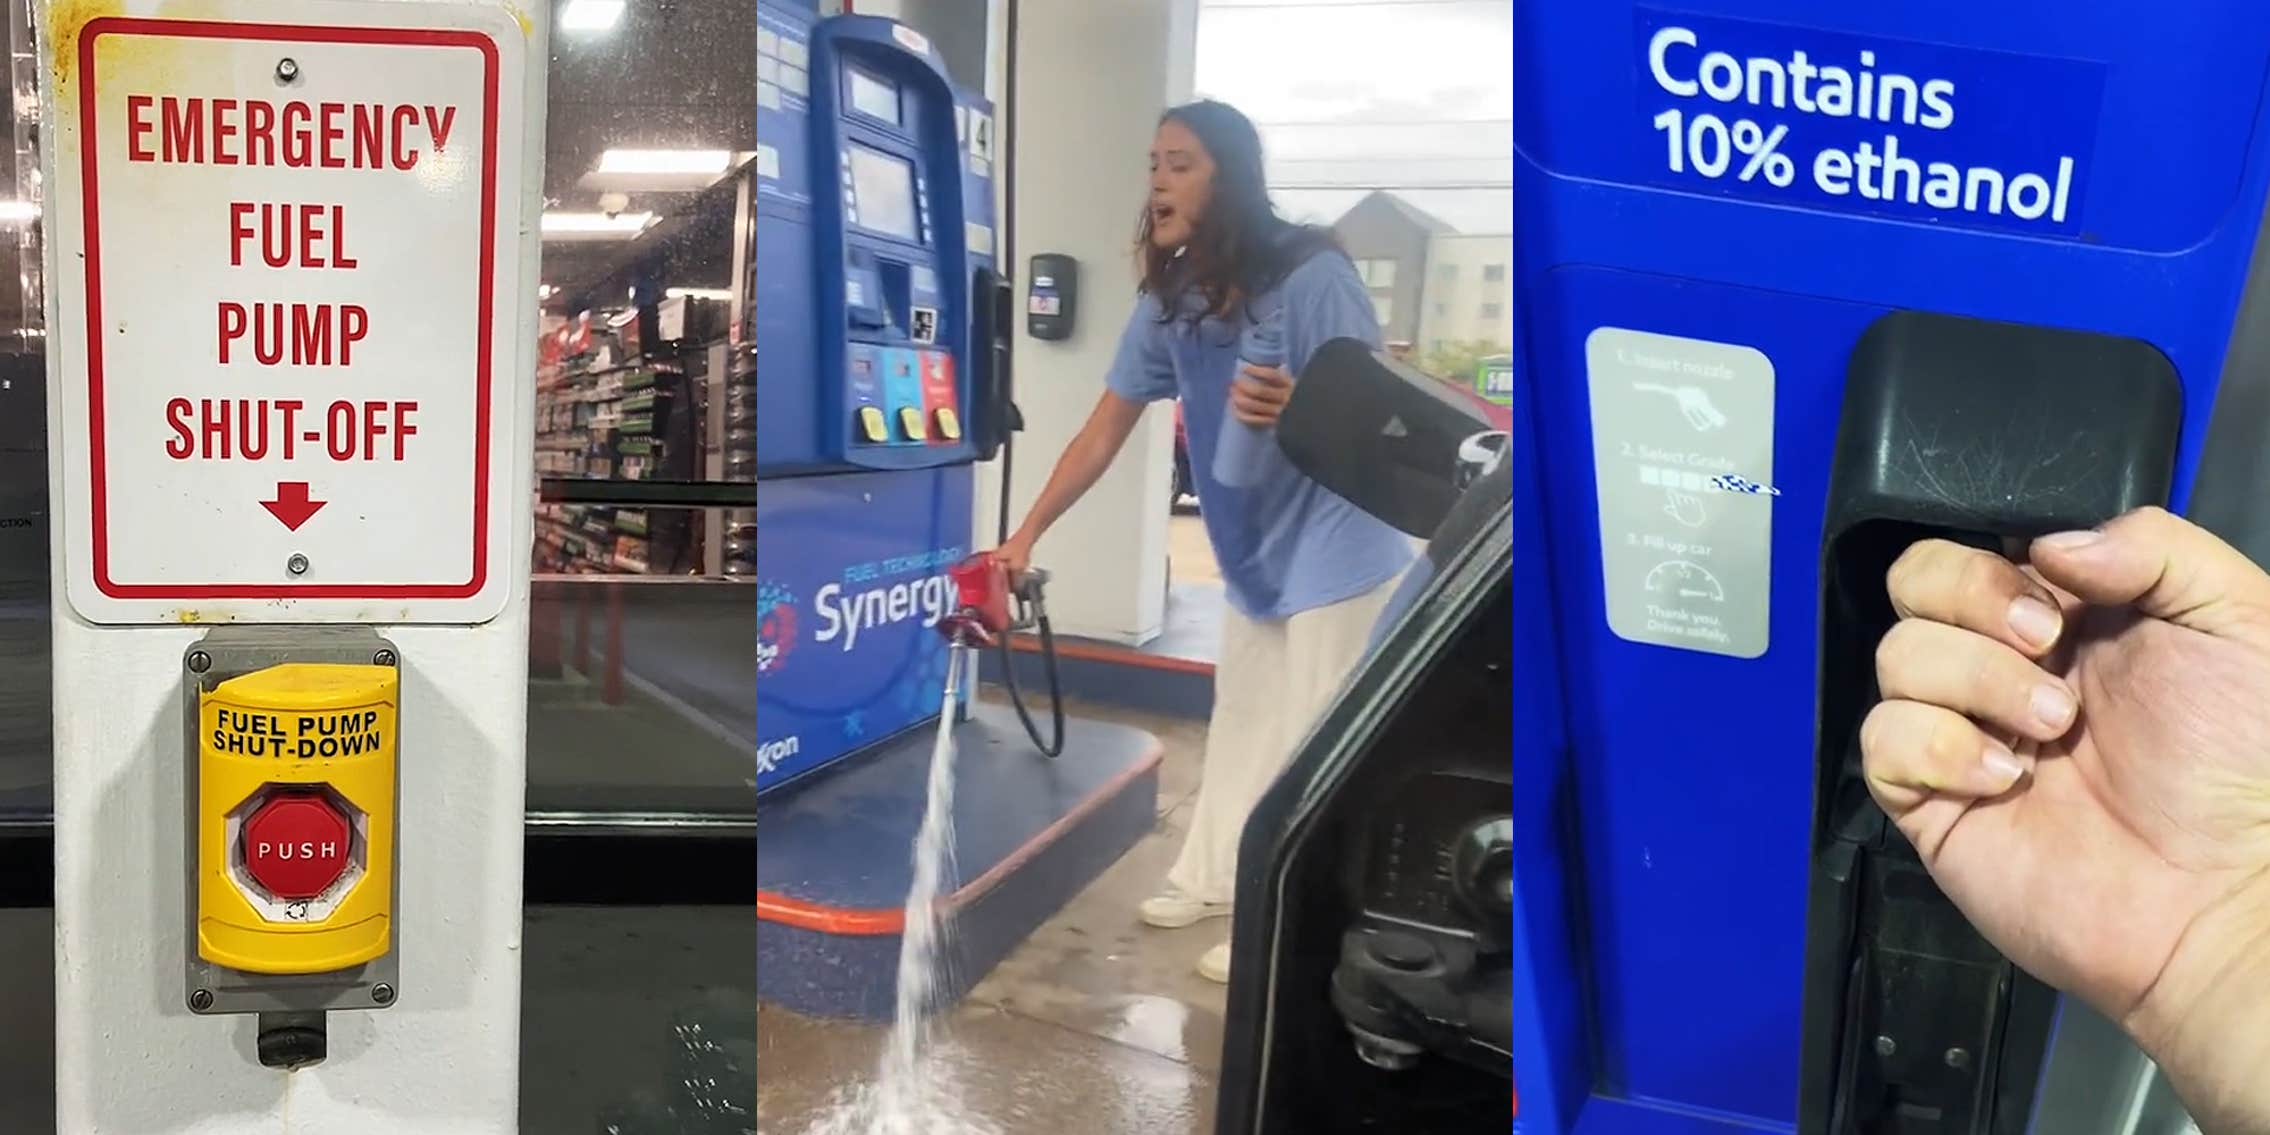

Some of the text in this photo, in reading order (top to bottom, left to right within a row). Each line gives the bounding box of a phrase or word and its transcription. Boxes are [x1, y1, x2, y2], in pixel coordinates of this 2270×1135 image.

[1648, 26, 1956, 131] Contains
[128, 96, 456, 171] EMERGENCY
[975, 117, 988, 152] 4
[1654, 109, 2075, 222] 10% ethanol
[230, 202, 358, 270] FUEL
[218, 302, 369, 367] PUMP
[1683, 362, 1735, 381] nozzle
[166, 397, 419, 461] SHUT-OFF
[1639, 445, 1685, 465] Select
[1688, 453, 1737, 471] Grade
[1644, 535, 1664, 549] Fill
[1667, 543, 1688, 556] up
[1690, 544, 1713, 557] car
[814, 574, 960, 653] Synergy
[1647, 605, 1689, 622] Thank
[1647, 619, 1685, 635] Drive
[217, 709, 379, 737] FUEL PUMP
[213, 730, 380, 758] SHUT-DOWN
[258, 842, 337, 860] PUSH
